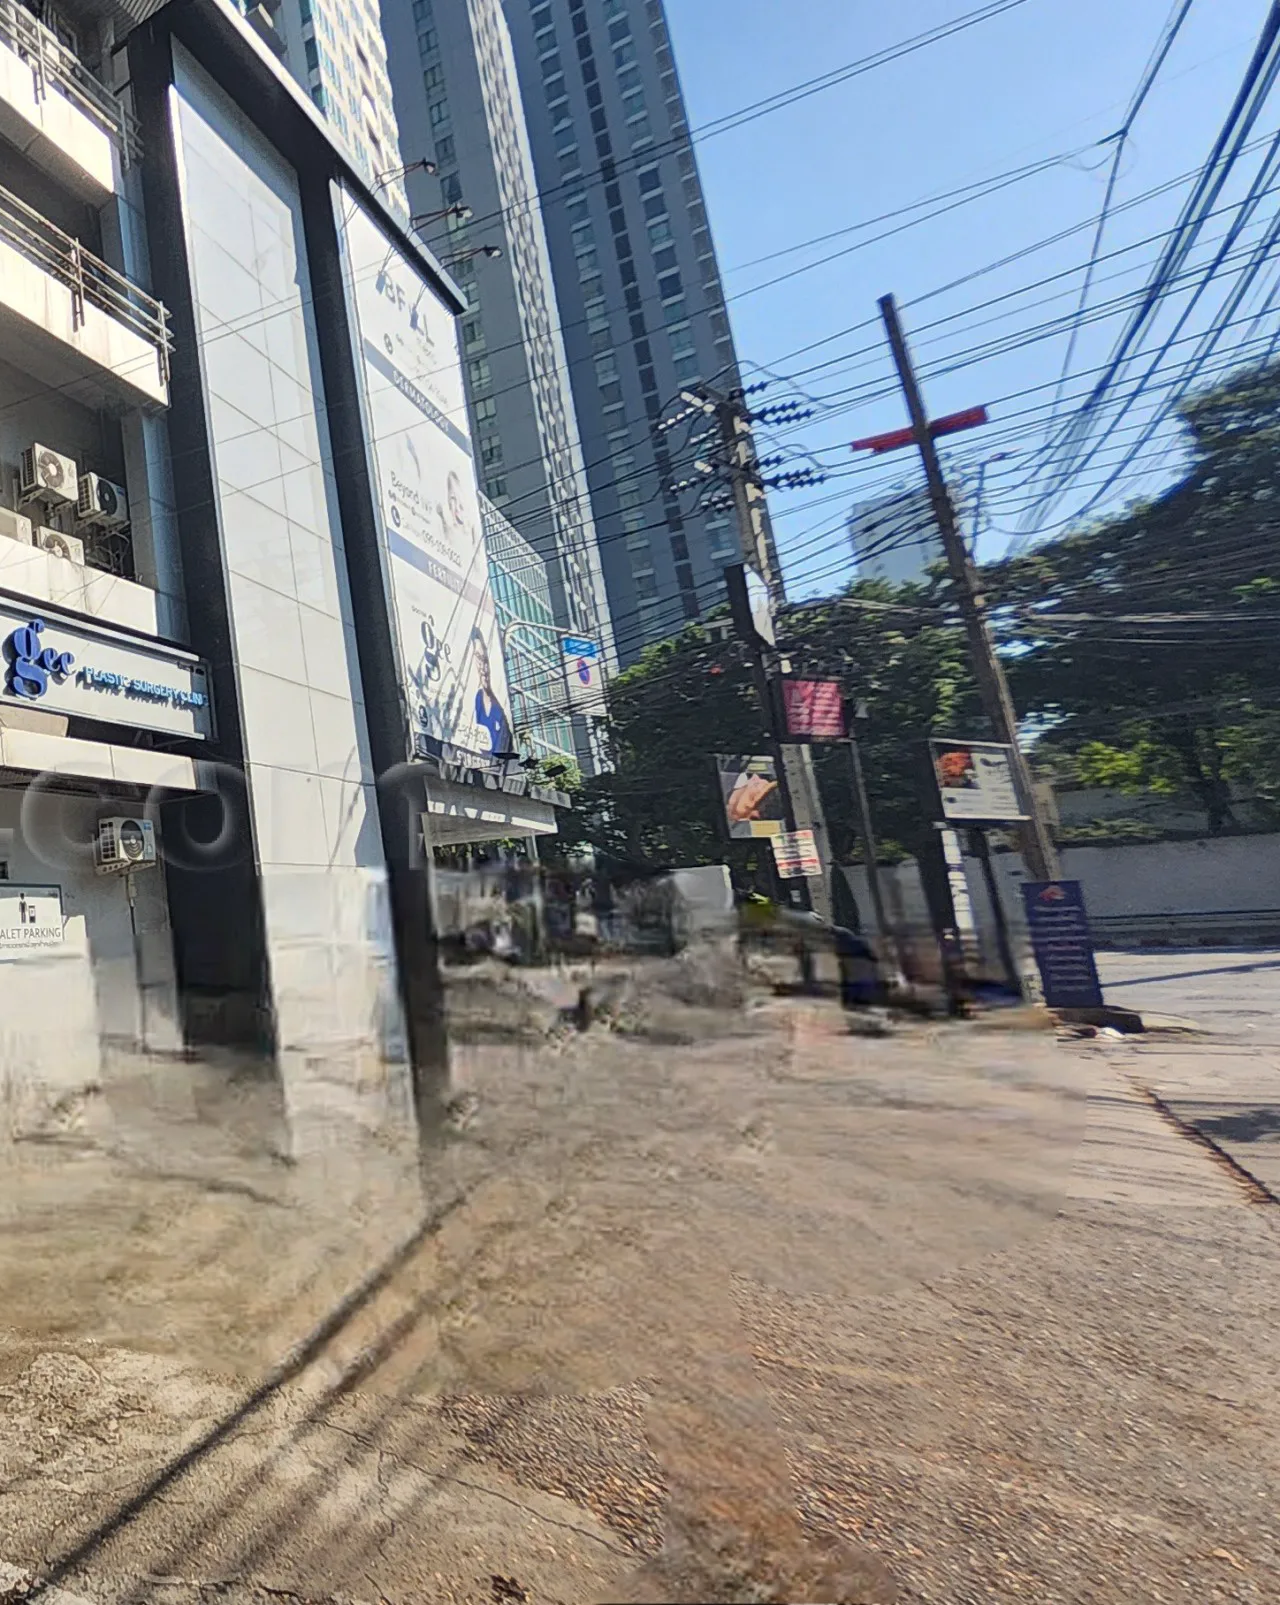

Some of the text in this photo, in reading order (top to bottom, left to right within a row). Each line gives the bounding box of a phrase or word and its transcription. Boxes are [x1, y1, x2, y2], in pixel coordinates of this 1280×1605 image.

[12, 618, 76, 698] gee
[84, 666, 131, 687] PLASTIC
[132, 678, 179, 700] SURGERY
[24, 927, 61, 939] PARKING
